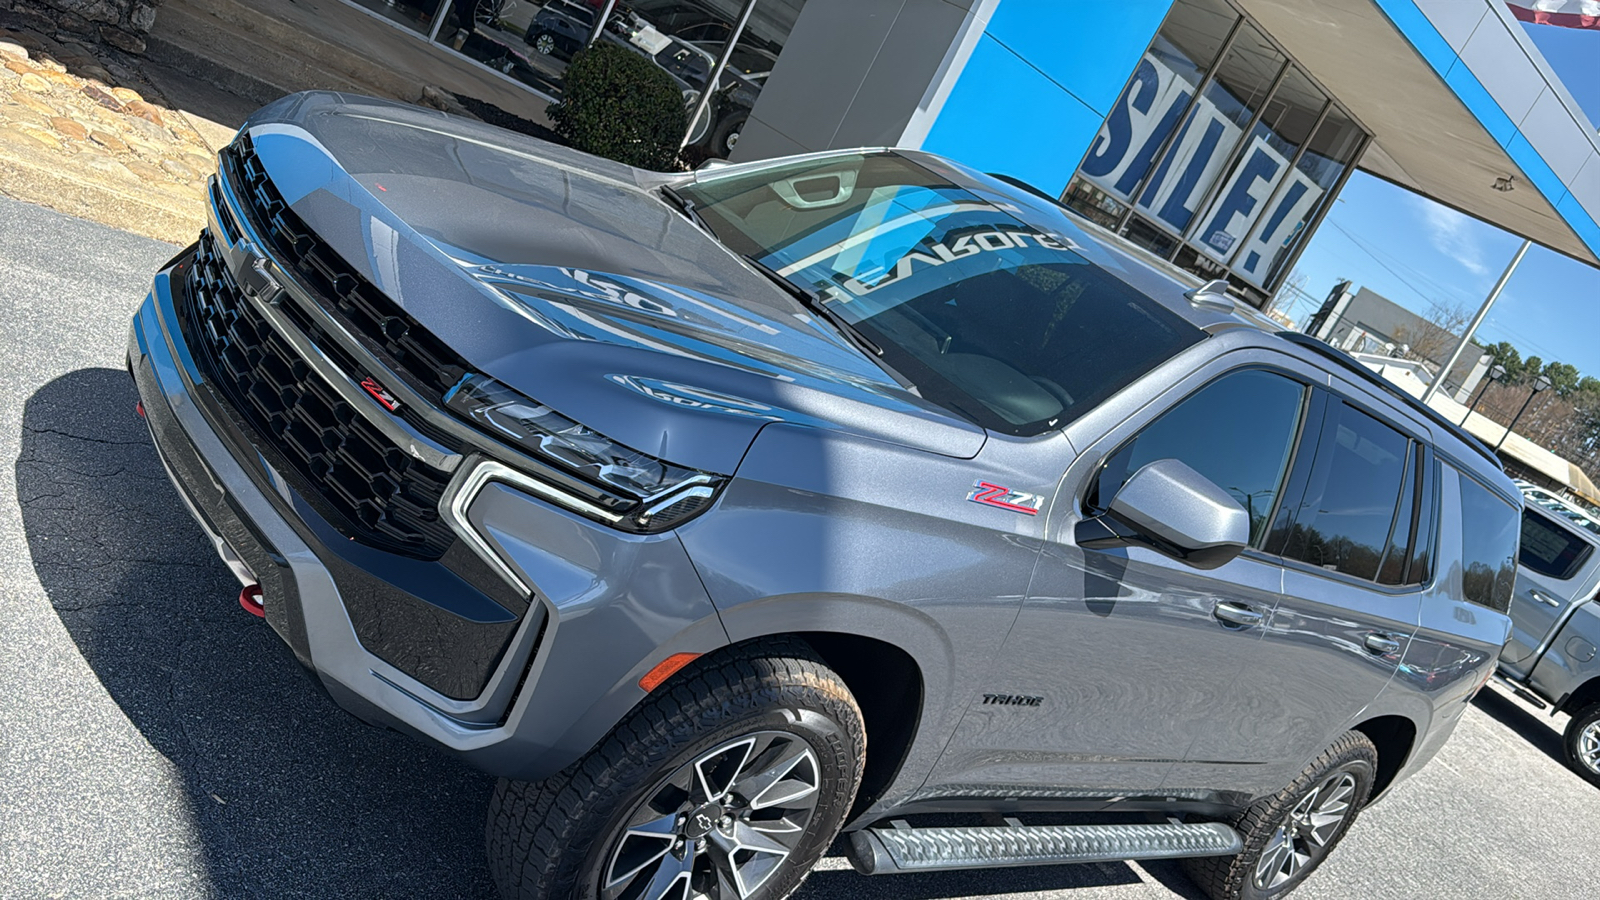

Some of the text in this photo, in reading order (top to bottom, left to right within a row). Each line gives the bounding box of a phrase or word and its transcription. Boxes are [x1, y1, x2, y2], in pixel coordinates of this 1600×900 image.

[1080, 58, 1309, 274] SALE!
[361, 376, 401, 411] Z71
[966, 480, 1045, 516] Z71
[982, 693, 1044, 707] TAHOE
